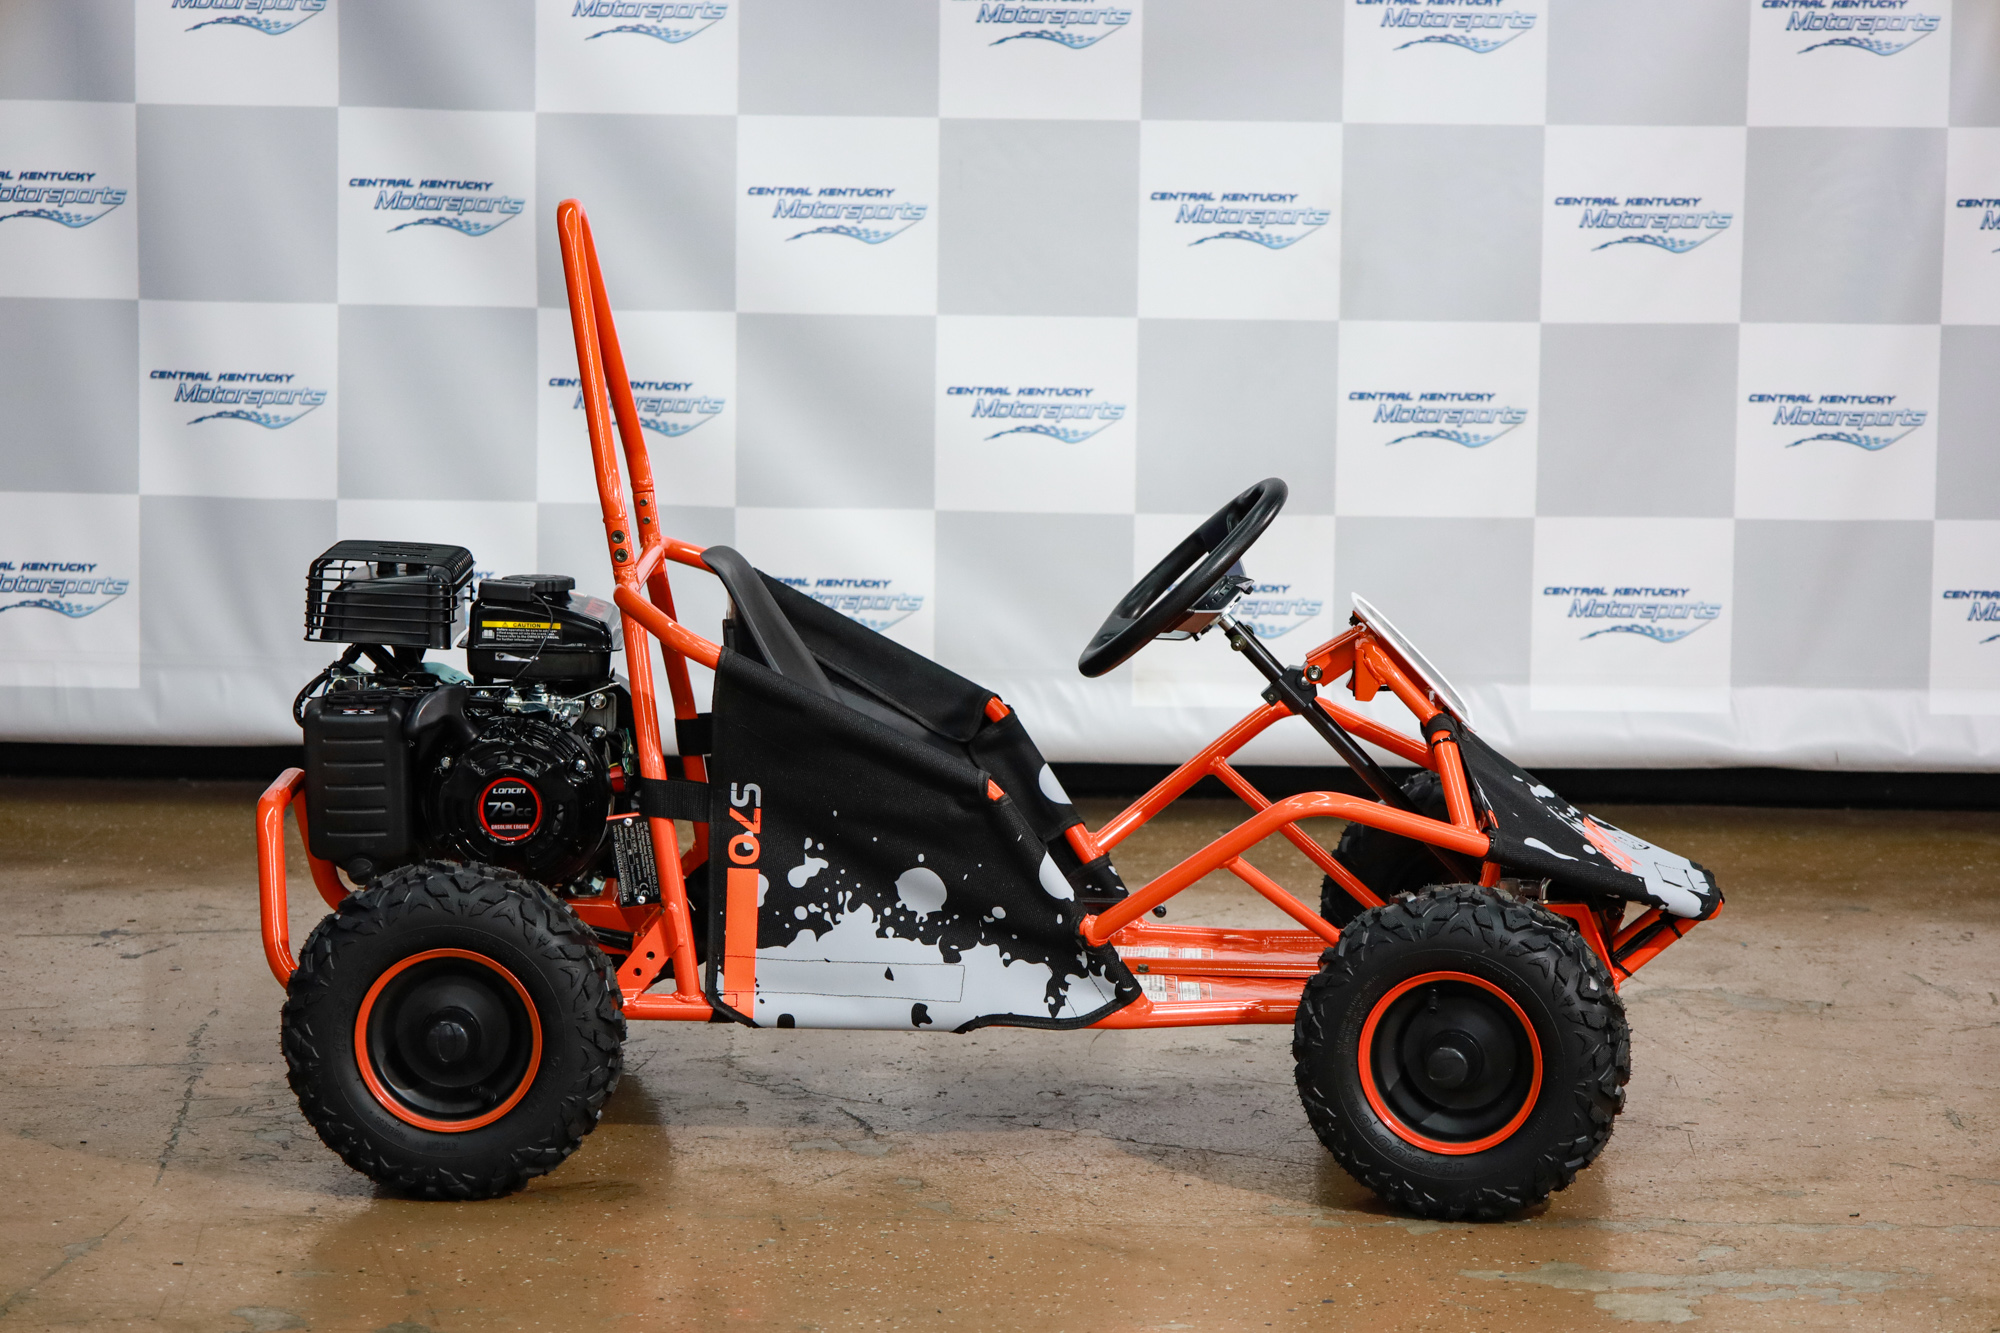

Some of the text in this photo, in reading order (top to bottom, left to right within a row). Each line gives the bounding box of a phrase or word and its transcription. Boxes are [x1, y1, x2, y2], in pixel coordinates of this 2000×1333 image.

[571, 0, 728, 22] Motorsports
[976, 3, 1132, 29] Motorsports
[1761, 0, 1908, 9] CENTRAL KENTUCKY
[1380, 8, 1537, 32] Motorsports
[1786, 11, 1941, 35] Motorsports
[18, 171, 96, 182] KENTUCKY
[349, 178, 494, 192] CENTRAL KENTUCKY
[0, 183, 127, 207] otorsports
[374, 190, 526, 215] Motorsports
[747, 187, 895, 198] CENTRAL KENTUCKY
[1150, 192, 1298, 203] CENTRAL KENTUCKY
[1554, 197, 1702, 207] CENTRAL KENTUCKY
[772, 199, 928, 223] Motorsports
[1175, 204, 1331, 229] Motorsports
[1579, 209, 1734, 233] Motorsports
[150, 370, 295, 383] CENTRAL KENTUCKY
[630, 380, 693, 391] ENTUCKY
[174, 383, 328, 408] Motorsports
[946, 386, 1093, 397] CENTRAL KENTUCKY
[1349, 392, 1496, 402] CENTRAL KENTUCKY
[1748, 394, 1896, 405] CENTRAL KENTUCKY
[971, 399, 1126, 423] Motorsports
[1373, 404, 1528, 428] Motorsports
[1773, 406, 1928, 431] Motorsports
[20, 562, 97, 573] KENTUCKY
[0, 574, 130, 598] otorsports
[816, 578, 891, 589] KENTUCKY
[1543, 587, 1690, 597] CENTRAL KENTUCKY
[1568, 598, 1722, 622] Motorsports
[728, 782, 761, 865] S70
